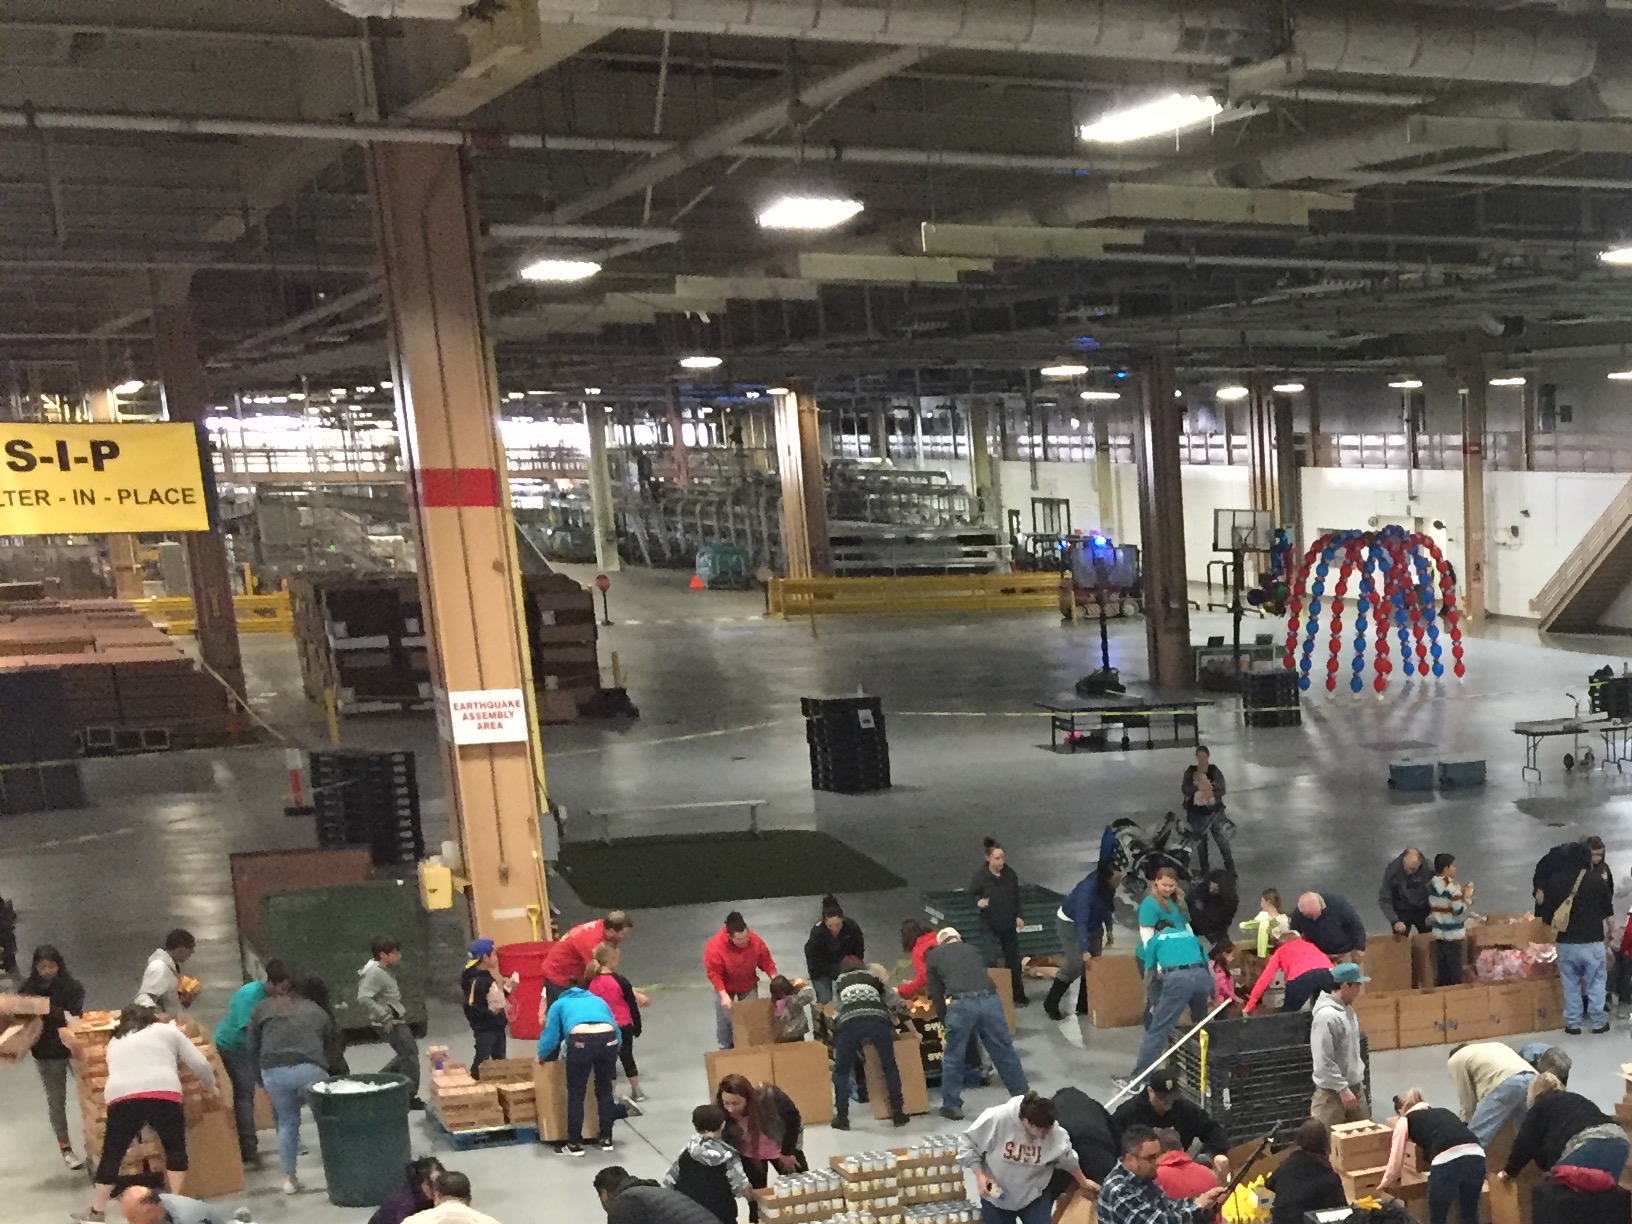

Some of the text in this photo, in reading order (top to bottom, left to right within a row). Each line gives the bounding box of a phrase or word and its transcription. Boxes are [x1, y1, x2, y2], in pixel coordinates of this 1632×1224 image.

[5, 439, 121, 472] S-I-P
[73, 489, 96, 505] IN
[117, 487, 197, 505] PLACE
[453, 700, 521, 711] EARTHQUAKE
[462, 710, 515, 721] ASSEMBLY
[477, 721, 504, 730] AREA
